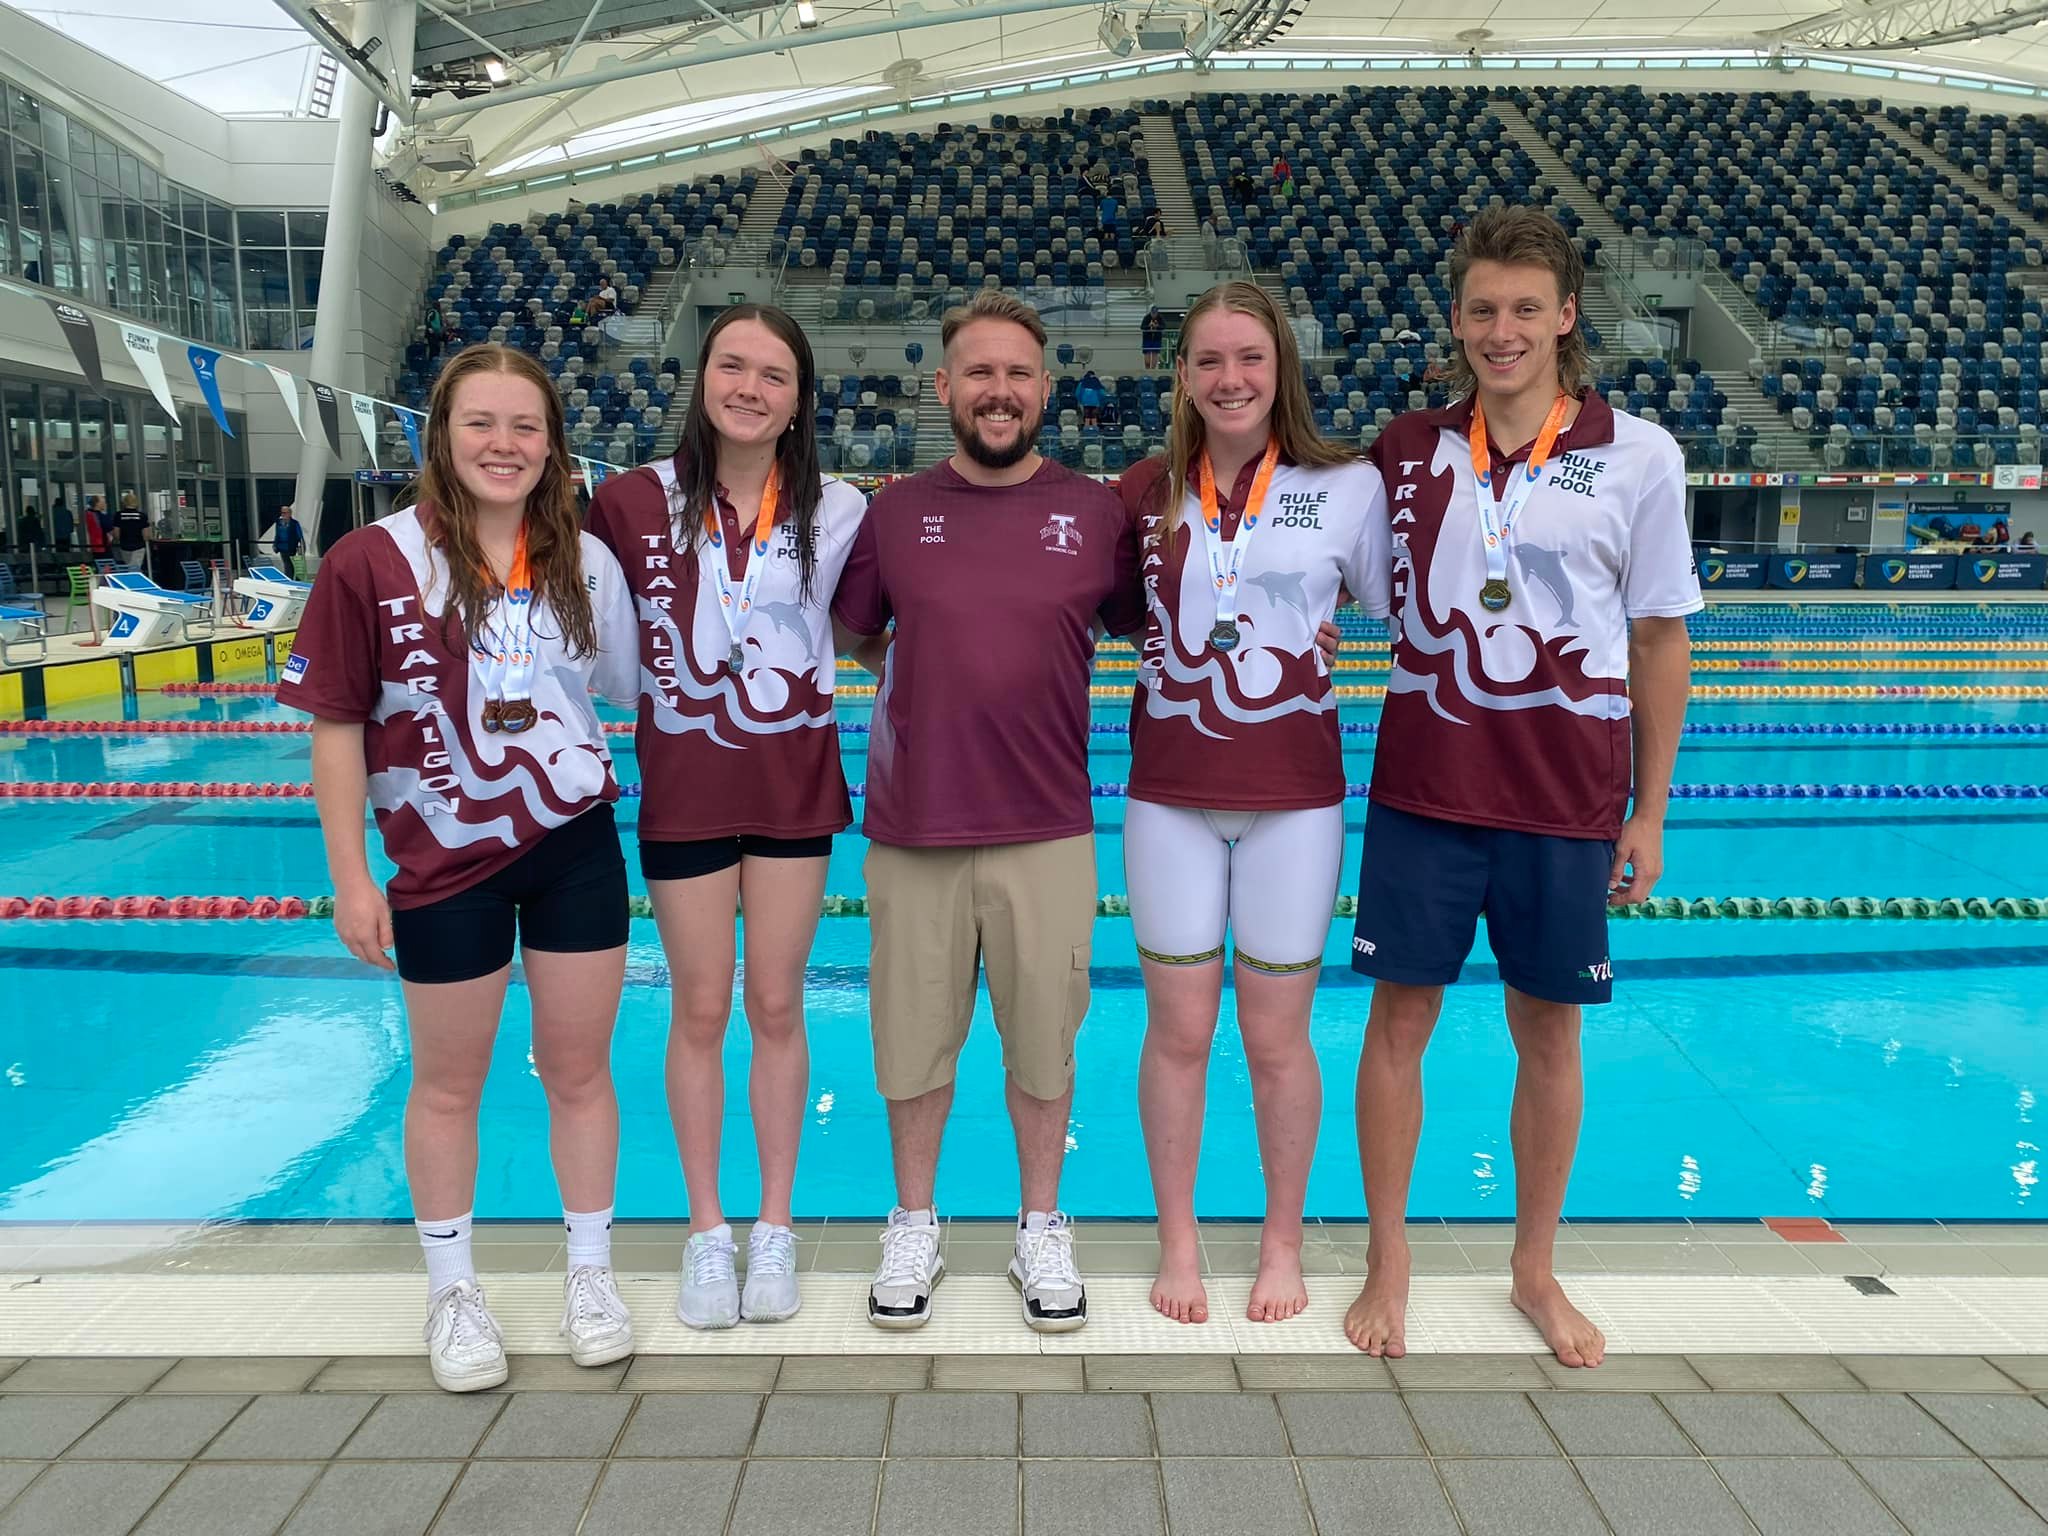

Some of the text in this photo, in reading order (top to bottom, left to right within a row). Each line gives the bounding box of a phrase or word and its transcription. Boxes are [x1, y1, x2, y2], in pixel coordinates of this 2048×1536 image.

[128, 333, 150, 345] FUNKY
[126, 340, 155, 354] TRUNKS
[1559, 452, 1606, 473] RULE
[1562, 466, 1597, 483] THE
[1549, 476, 1596, 498] POOL
[1279, 492, 1328, 504] RULE
[1283, 504, 1319, 516] THE
[1271, 516, 1324, 530] POOL
[781, 525, 821, 537] RUE
[784, 536, 815, 549] TE
[920, 536, 946, 544] POOL
[777, 548, 819, 562] POL
[1391, 461, 1424, 669] TRARAL
[257, 604, 267, 618] 5
[118, 618, 129, 634] 4
[641, 535, 681, 708] TRARALGON
[235, 646, 262, 660] OMEGA
[277, 640, 293, 652] OME
[379, 595, 462, 817] TRARALGON
